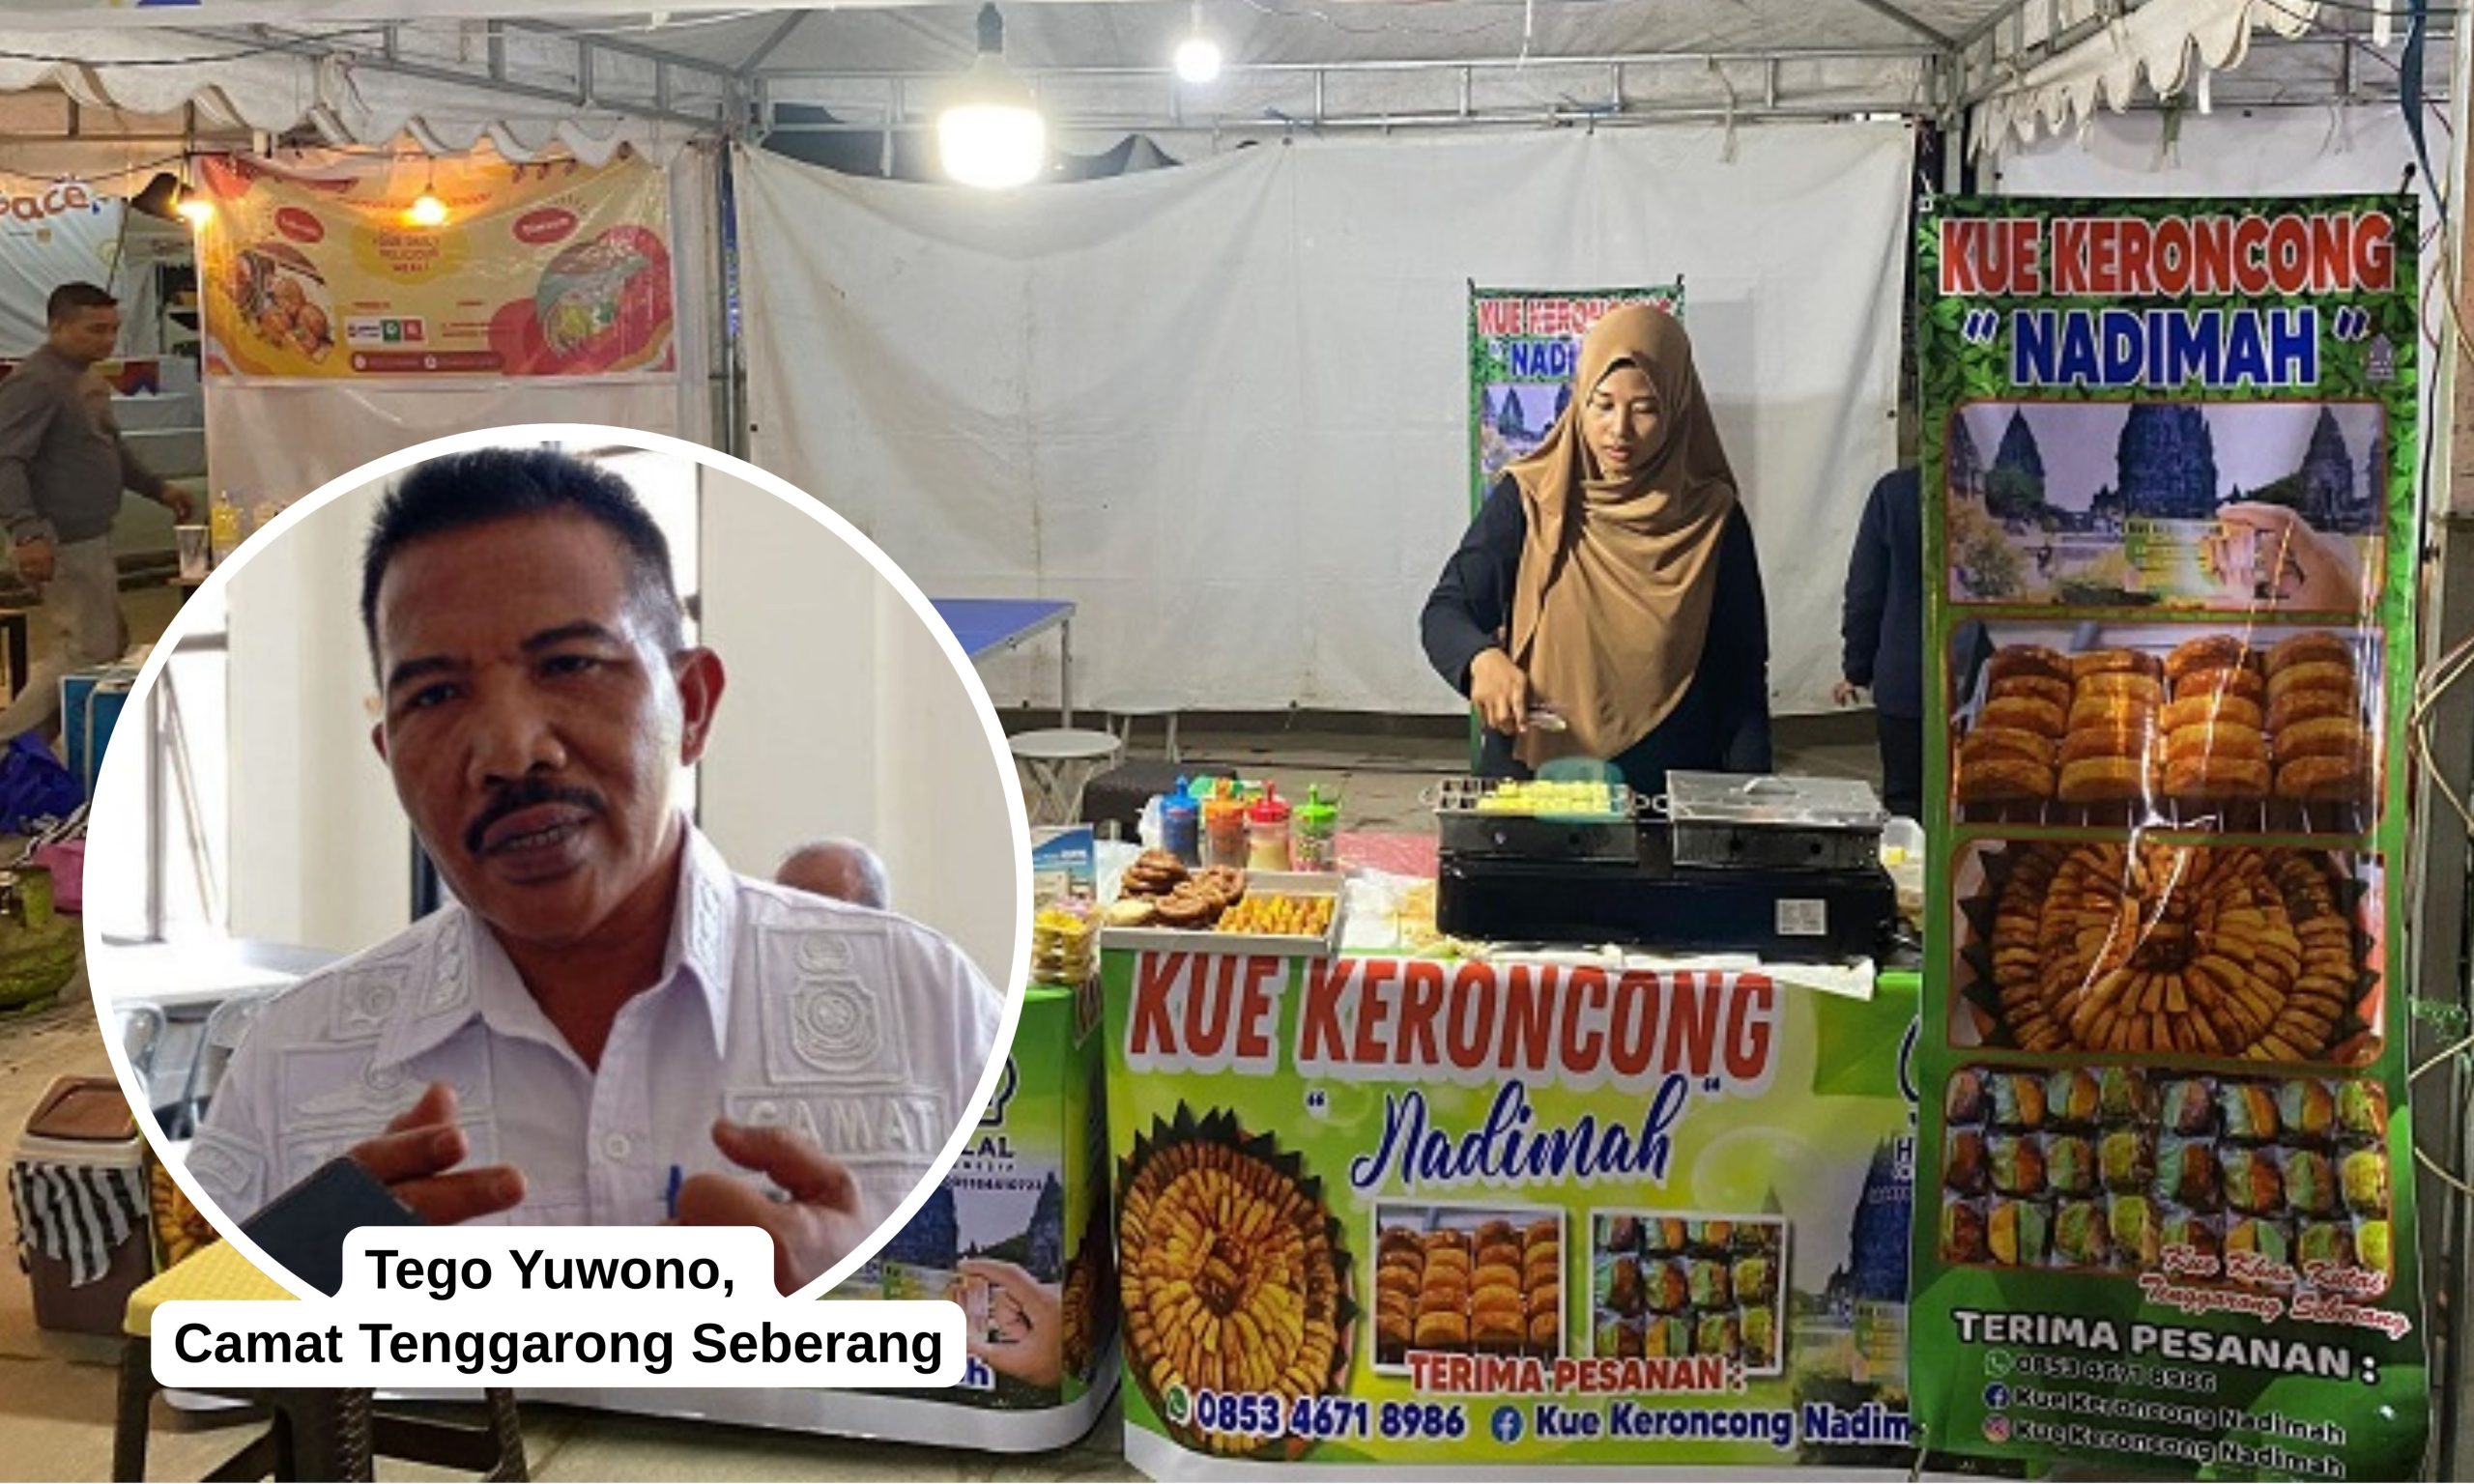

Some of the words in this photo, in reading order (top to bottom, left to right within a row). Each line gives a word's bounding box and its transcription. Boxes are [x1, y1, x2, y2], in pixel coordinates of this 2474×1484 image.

[1941, 219, 2041, 294] KUE
[2052, 214, 2395, 296] KERONCONG
[1479, 300, 1521, 334] KUE
[1512, 341, 1575, 377] NADI
[2013, 309, 2317, 385] NADIMAH
[1129, 951, 1281, 1060] KUE
[1300, 956, 1774, 1080] KERONCONG
[1352, 1073, 1688, 1187] Nadimah
[1408, 1353, 1542, 1392] TERIMA
[1554, 1357, 1723, 1392] PESANAN
[1955, 1311, 2119, 1352] TERIMA
[2132, 1326, 2350, 1379] PESANAN
[1197, 1392, 1280, 1434] 0853
[1291, 1398, 1368, 1436] 4671
[1380, 1403, 1466, 1438] 8986
[1537, 1406, 1599, 1436] Kue
[1610, 1403, 1794, 1444] Keroncong
[1804, 1405, 1912, 1442] Nadim
[2014, 1387, 2066, 1412] Kue
[2069, 1391, 2217, 1431] Keroncong
[2220, 1407, 2345, 1445] Nadimah
[2014, 1419, 2066, 1444] Kue
[2069, 1424, 2217, 1468] Keroncong
[2220, 1441, 2345, 1479] Nadimah
